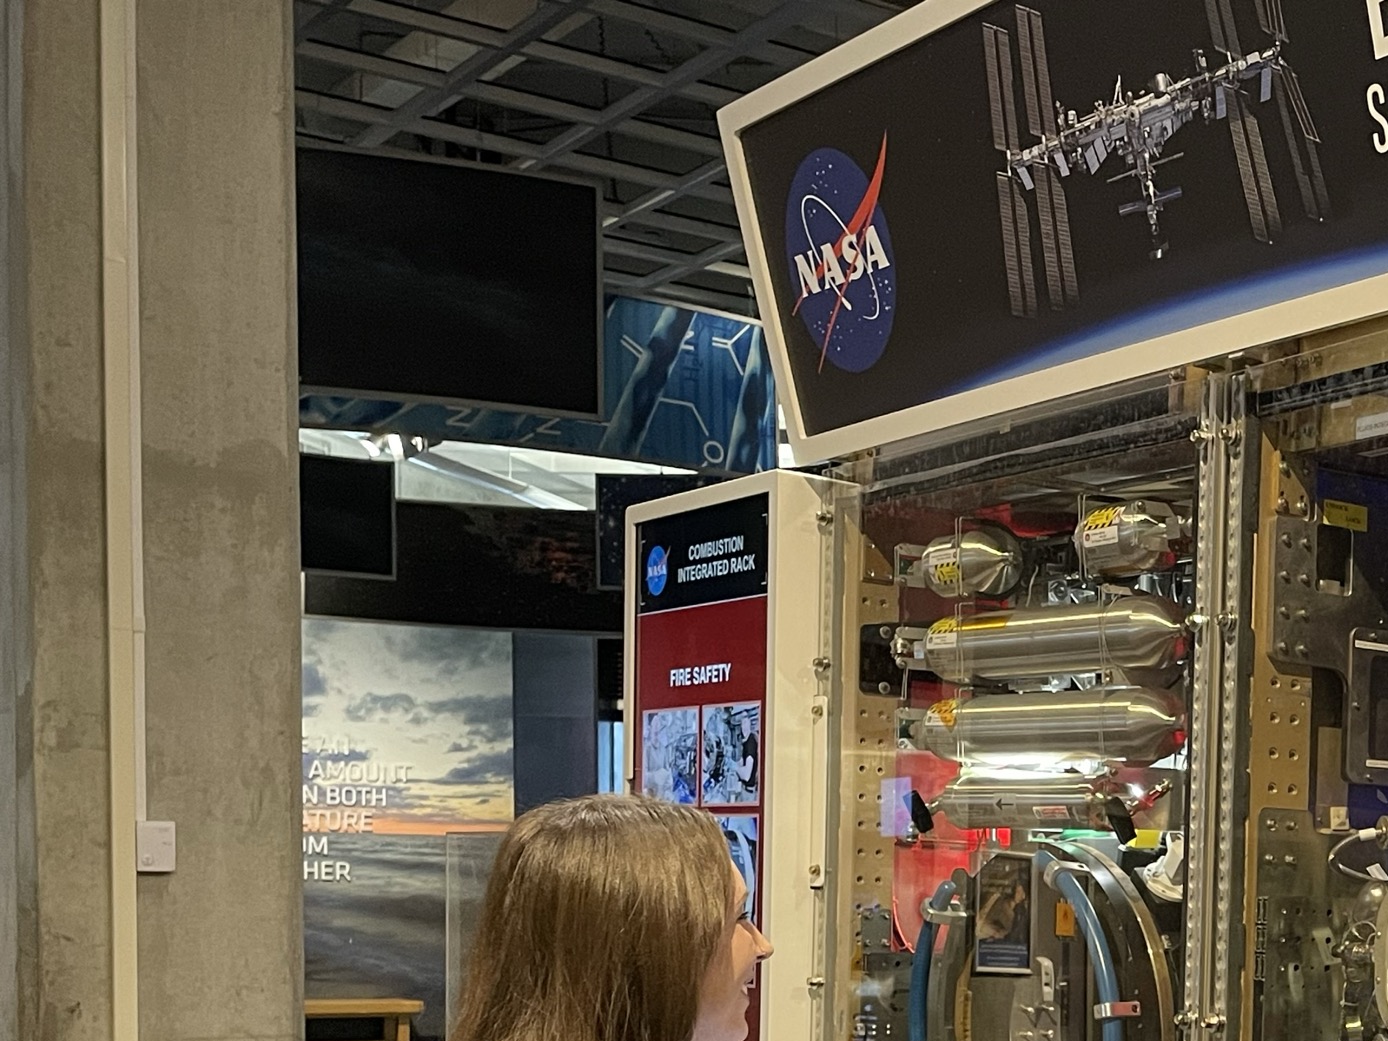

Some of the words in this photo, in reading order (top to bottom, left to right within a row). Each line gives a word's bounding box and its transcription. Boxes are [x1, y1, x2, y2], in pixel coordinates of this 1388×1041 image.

[794, 225, 890, 298] NASA
[688, 535, 744, 561] COMBUSTION
[648, 563, 667, 577] NASA
[677, 558, 729, 584] INTEGRATED
[730, 553, 756, 575] RACK
[669, 666, 692, 688] FIRE
[692, 662, 732, 686] SAFETY
[308, 760, 412, 783] AMOUNT
[326, 786, 387, 807] BOTH
